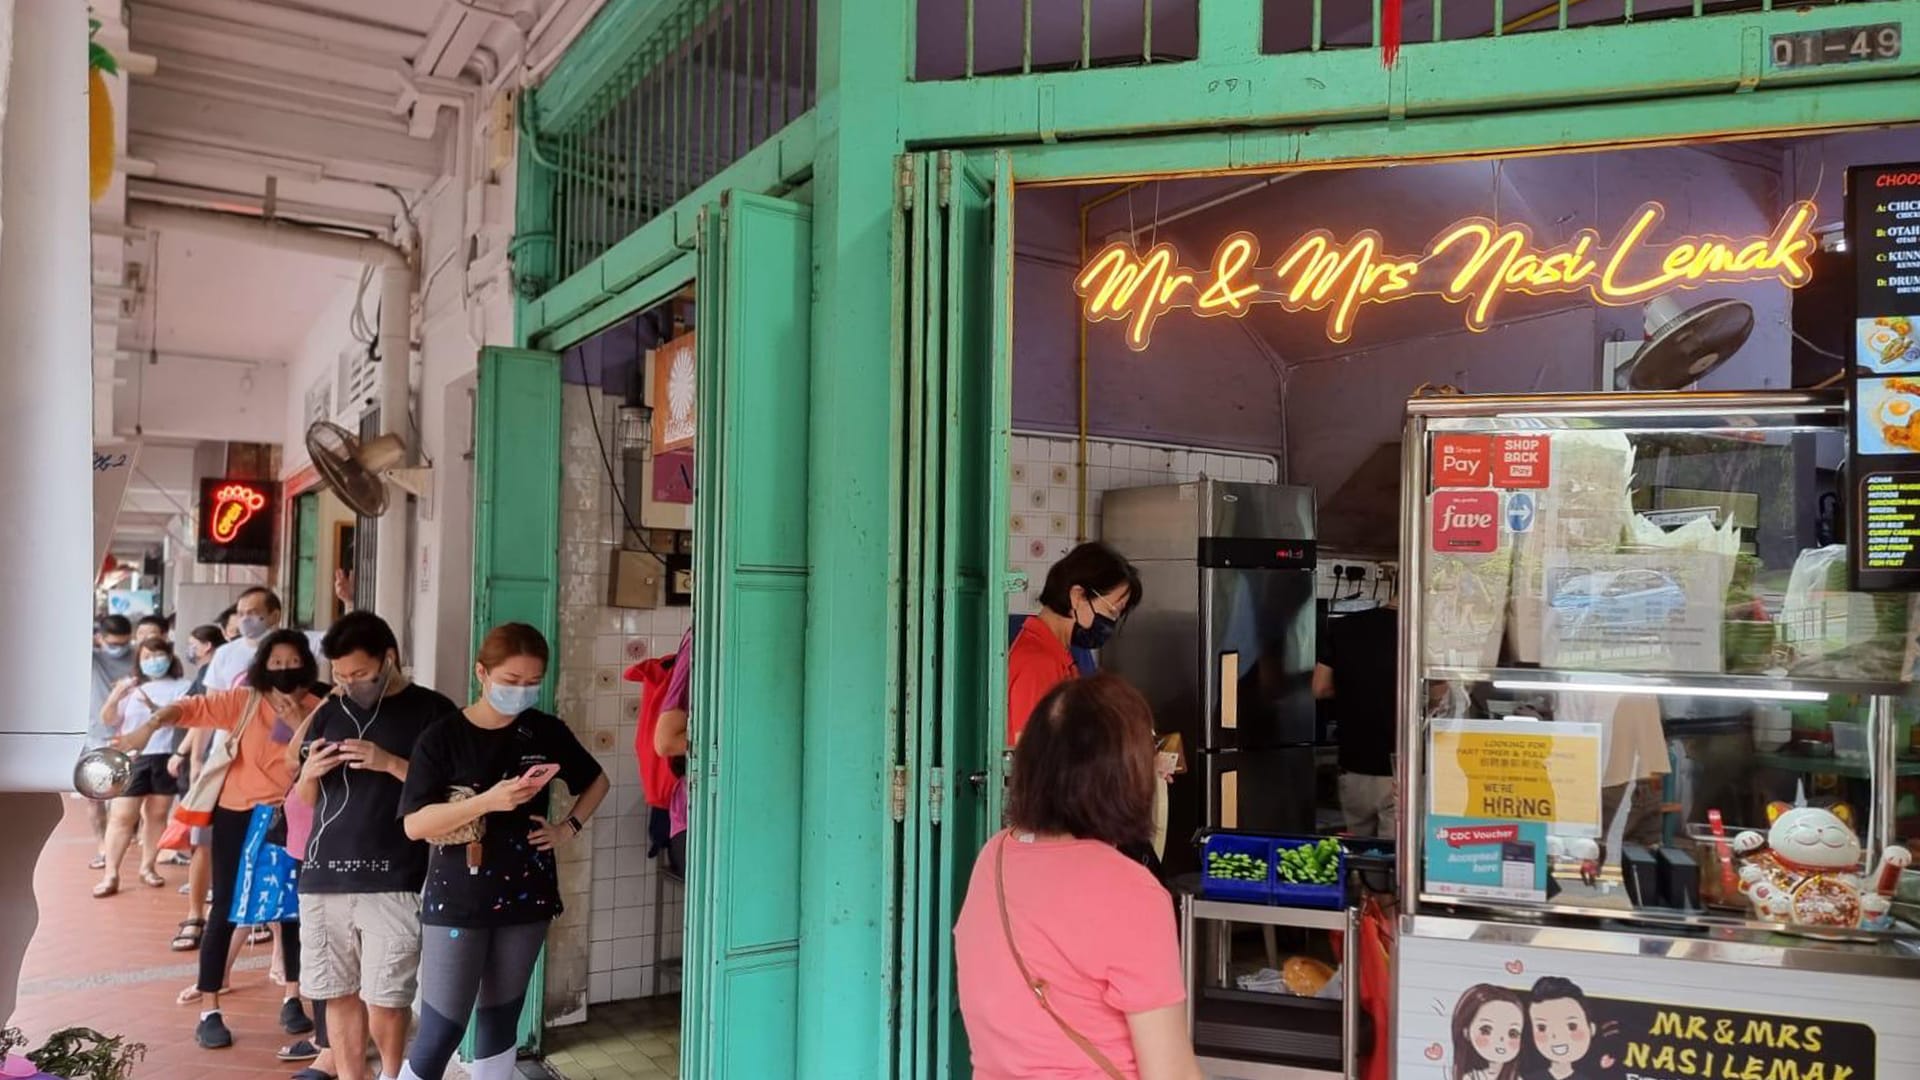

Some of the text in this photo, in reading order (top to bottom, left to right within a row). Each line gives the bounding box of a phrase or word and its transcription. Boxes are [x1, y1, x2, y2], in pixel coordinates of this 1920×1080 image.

[1773, 27, 1898, 66] 01-49
[1081, 207, 1808, 343] Mr & Mrs Nasi Lemak
[1504, 440, 1540, 451] SHOP
[1443, 455, 1481, 476] Pay
[1503, 452, 1539, 463] BACK
[1438, 505, 1492, 532] fave
[1483, 797, 1552, 818] HIRING
[1450, 830, 1514, 841] CDC Voucher
[1472, 864, 1498, 873] here
[1649, 1011, 1824, 1053] MR & MRS
[1623, 1042, 1854, 1080] NASI LEMAK
